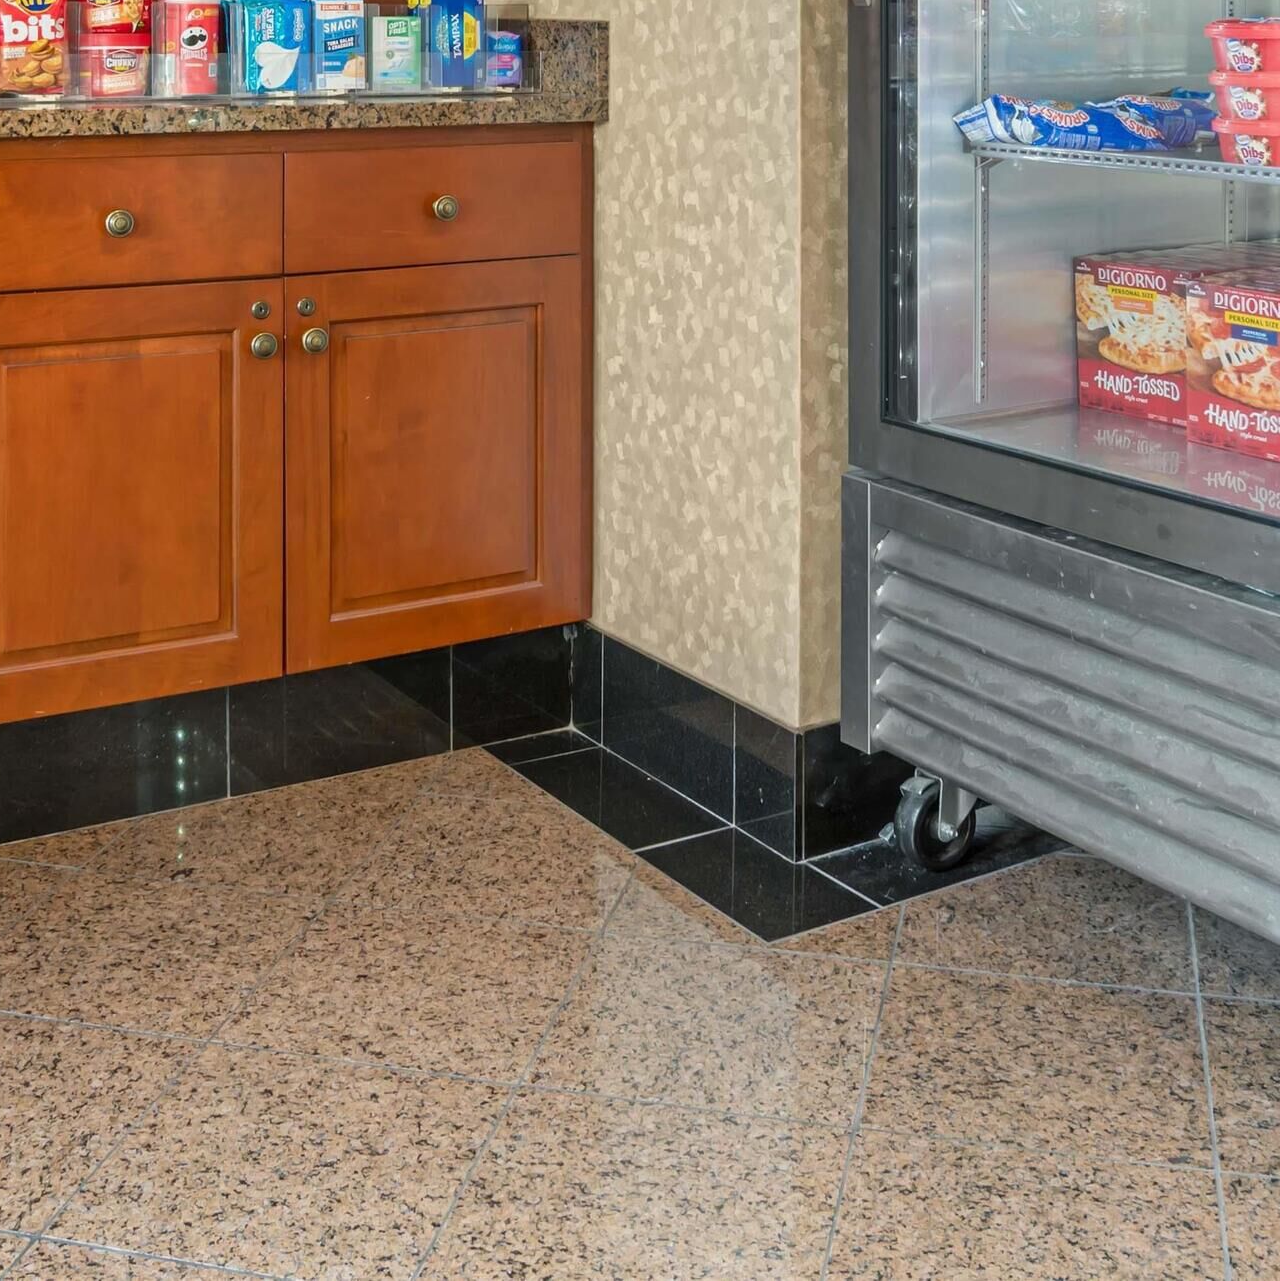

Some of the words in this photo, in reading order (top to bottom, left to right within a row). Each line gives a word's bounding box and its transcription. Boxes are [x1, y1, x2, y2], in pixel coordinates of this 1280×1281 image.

[3, 14, 65, 42] bits
[323, 19, 359, 33] SNACK
[452, 13, 462, 59] TAMPAX
[106, 58, 136, 68] CHUNKY
[1232, 52, 1256, 66] Dibs
[1236, 98, 1260, 112] Dibs
[1241, 147, 1265, 161] Dibs
[1097, 267, 1168, 291] DIGIORNO
[1111, 287, 1142, 299] PERSONAL
[1142, 291, 1155, 300] SIZE
[1228, 314, 1263, 327] PERSONAL
[1264, 319, 1280, 330] SIZE
[1094, 370, 1181, 402] HAND-TOSSED
